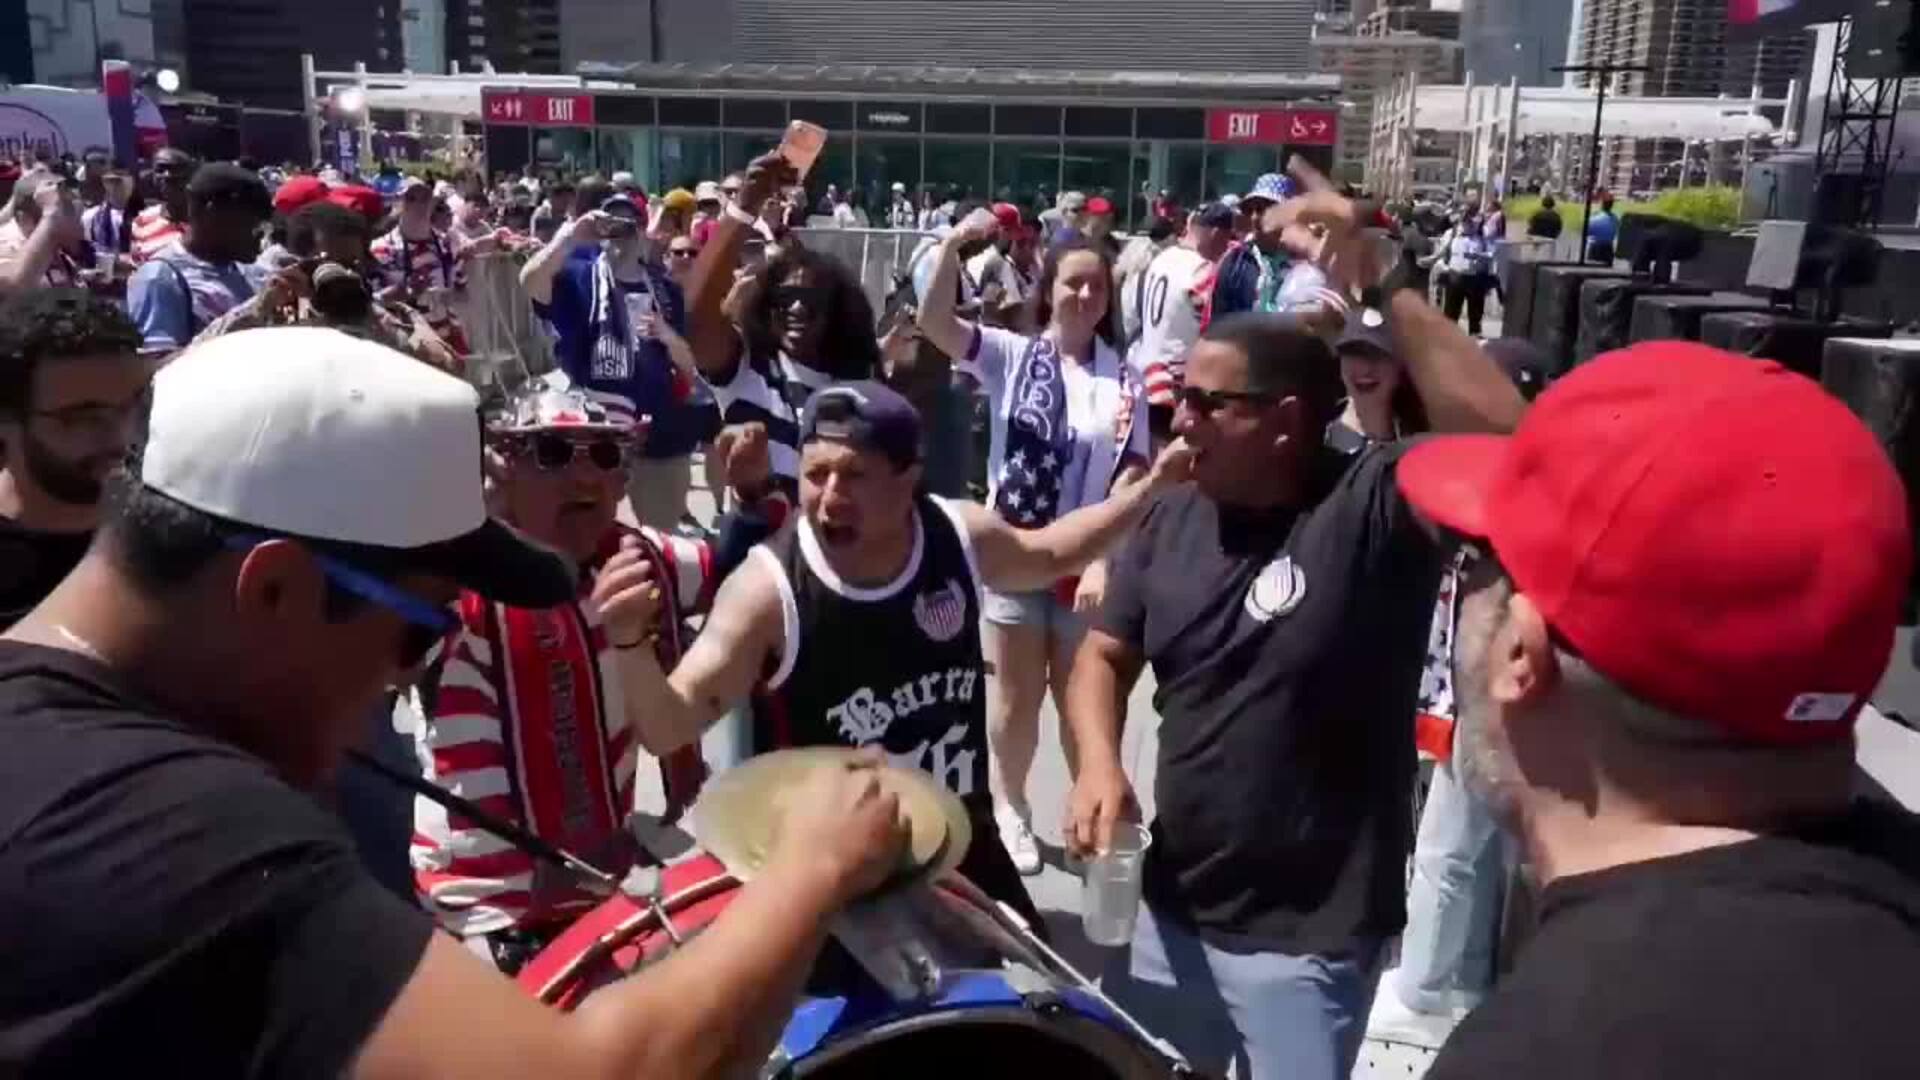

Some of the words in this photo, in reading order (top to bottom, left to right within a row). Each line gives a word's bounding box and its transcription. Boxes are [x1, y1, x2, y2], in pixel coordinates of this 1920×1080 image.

[547, 97, 575, 121] EXIT
[1228, 113, 1260, 138] EXIT
[826, 667, 977, 744] Barra
